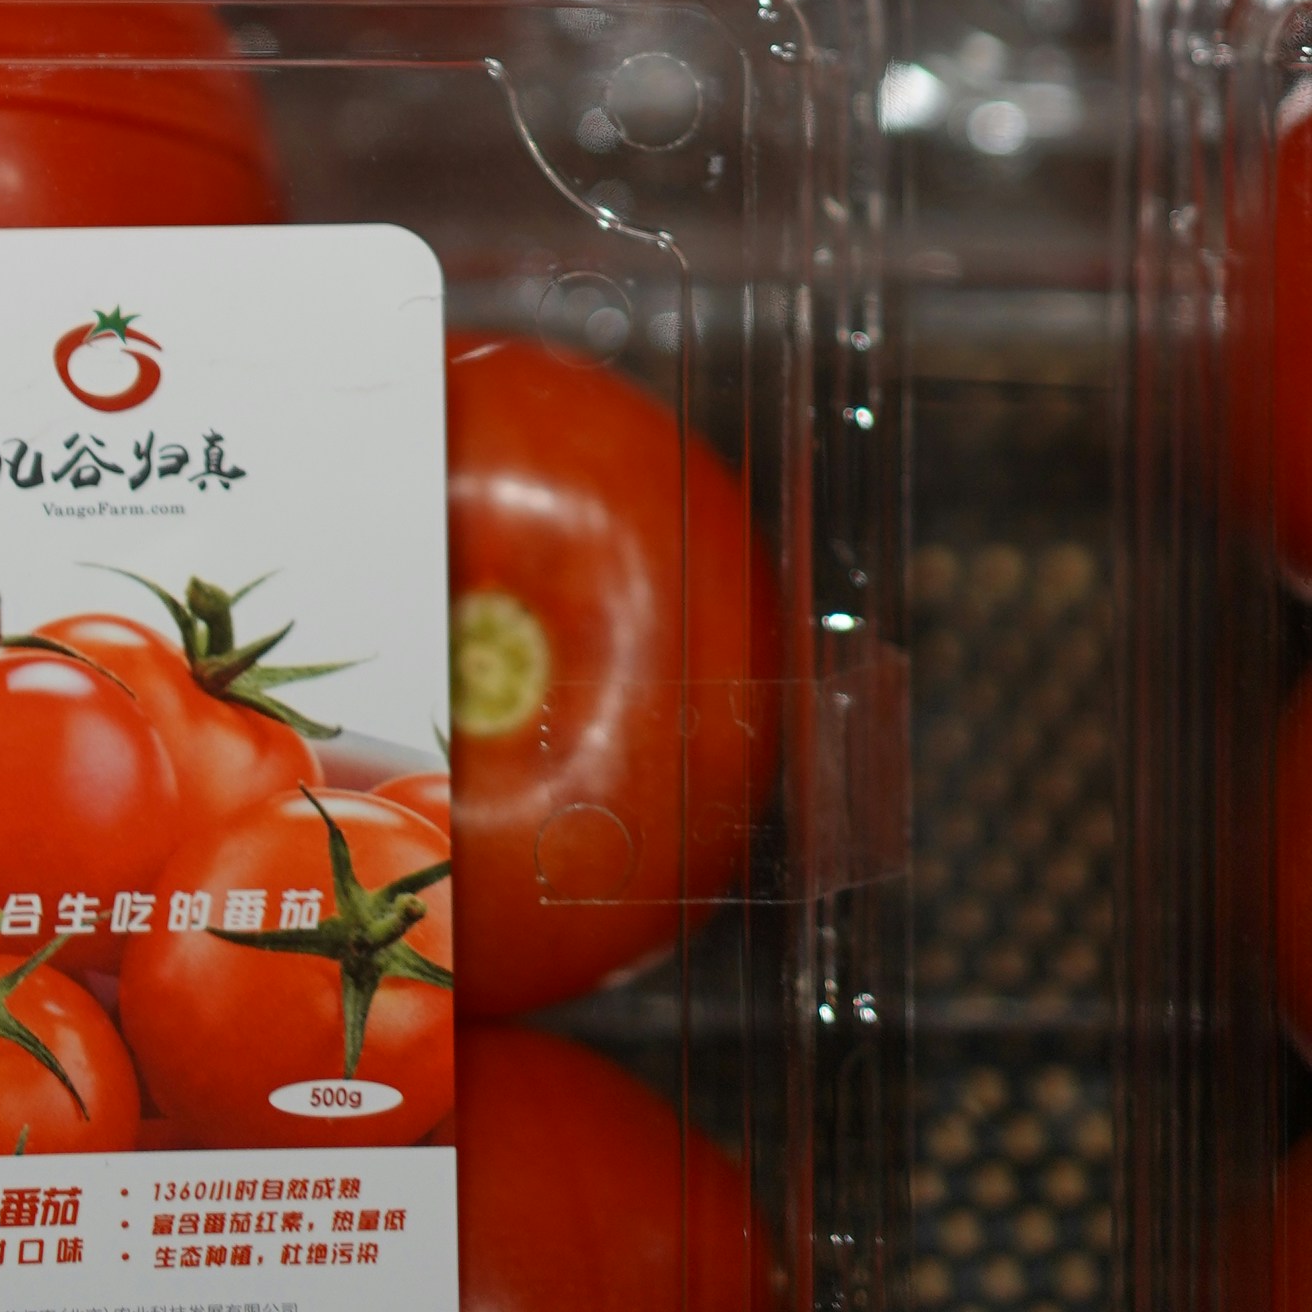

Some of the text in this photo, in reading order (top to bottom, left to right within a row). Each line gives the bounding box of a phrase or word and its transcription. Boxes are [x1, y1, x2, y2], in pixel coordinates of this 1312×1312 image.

[42, 502, 186, 519] VangoFarm.com
[310, 1087, 362, 1109] 500g
[154, 1177, 362, 1201] 1360小时自然成熟
